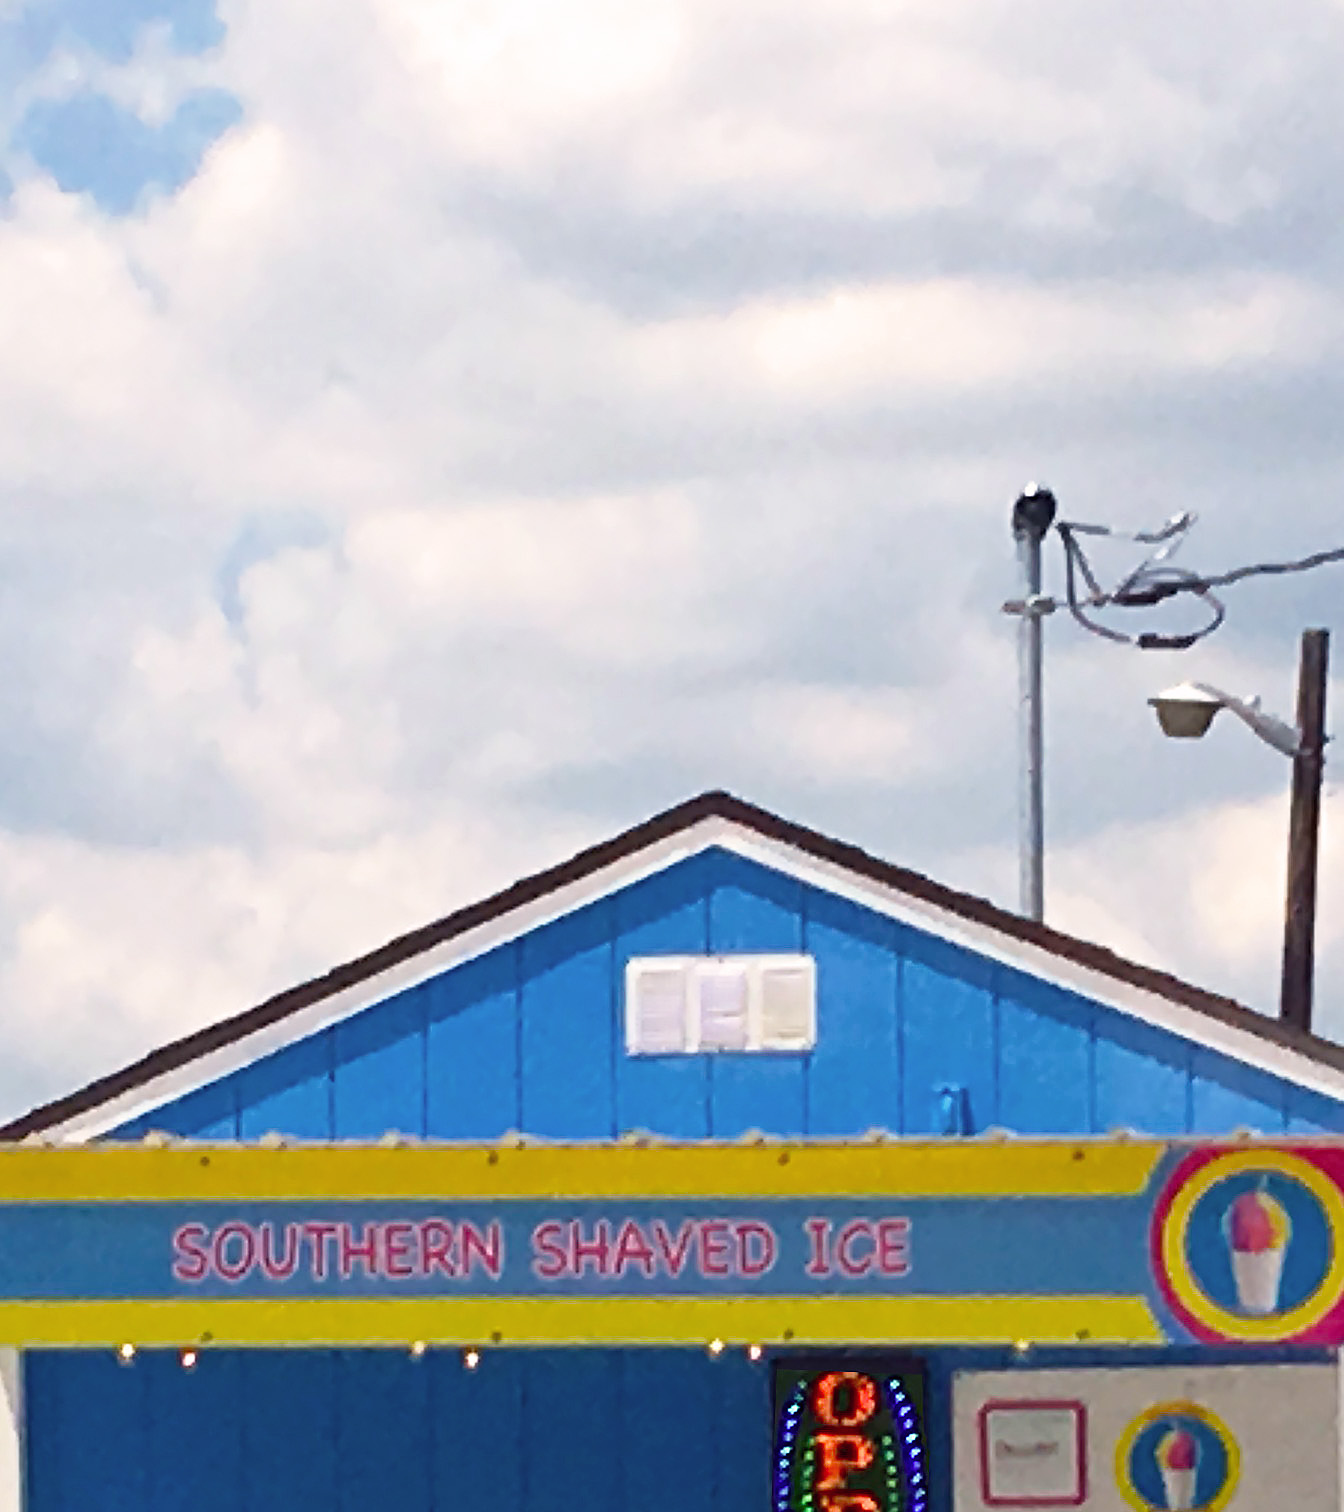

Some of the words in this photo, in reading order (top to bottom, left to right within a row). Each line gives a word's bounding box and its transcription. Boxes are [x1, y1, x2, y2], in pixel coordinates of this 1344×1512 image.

[172, 1218, 501, 1283] SOUTHERN
[532, 1217, 777, 1279] SHAVED
[804, 1216, 913, 1278] ICE
